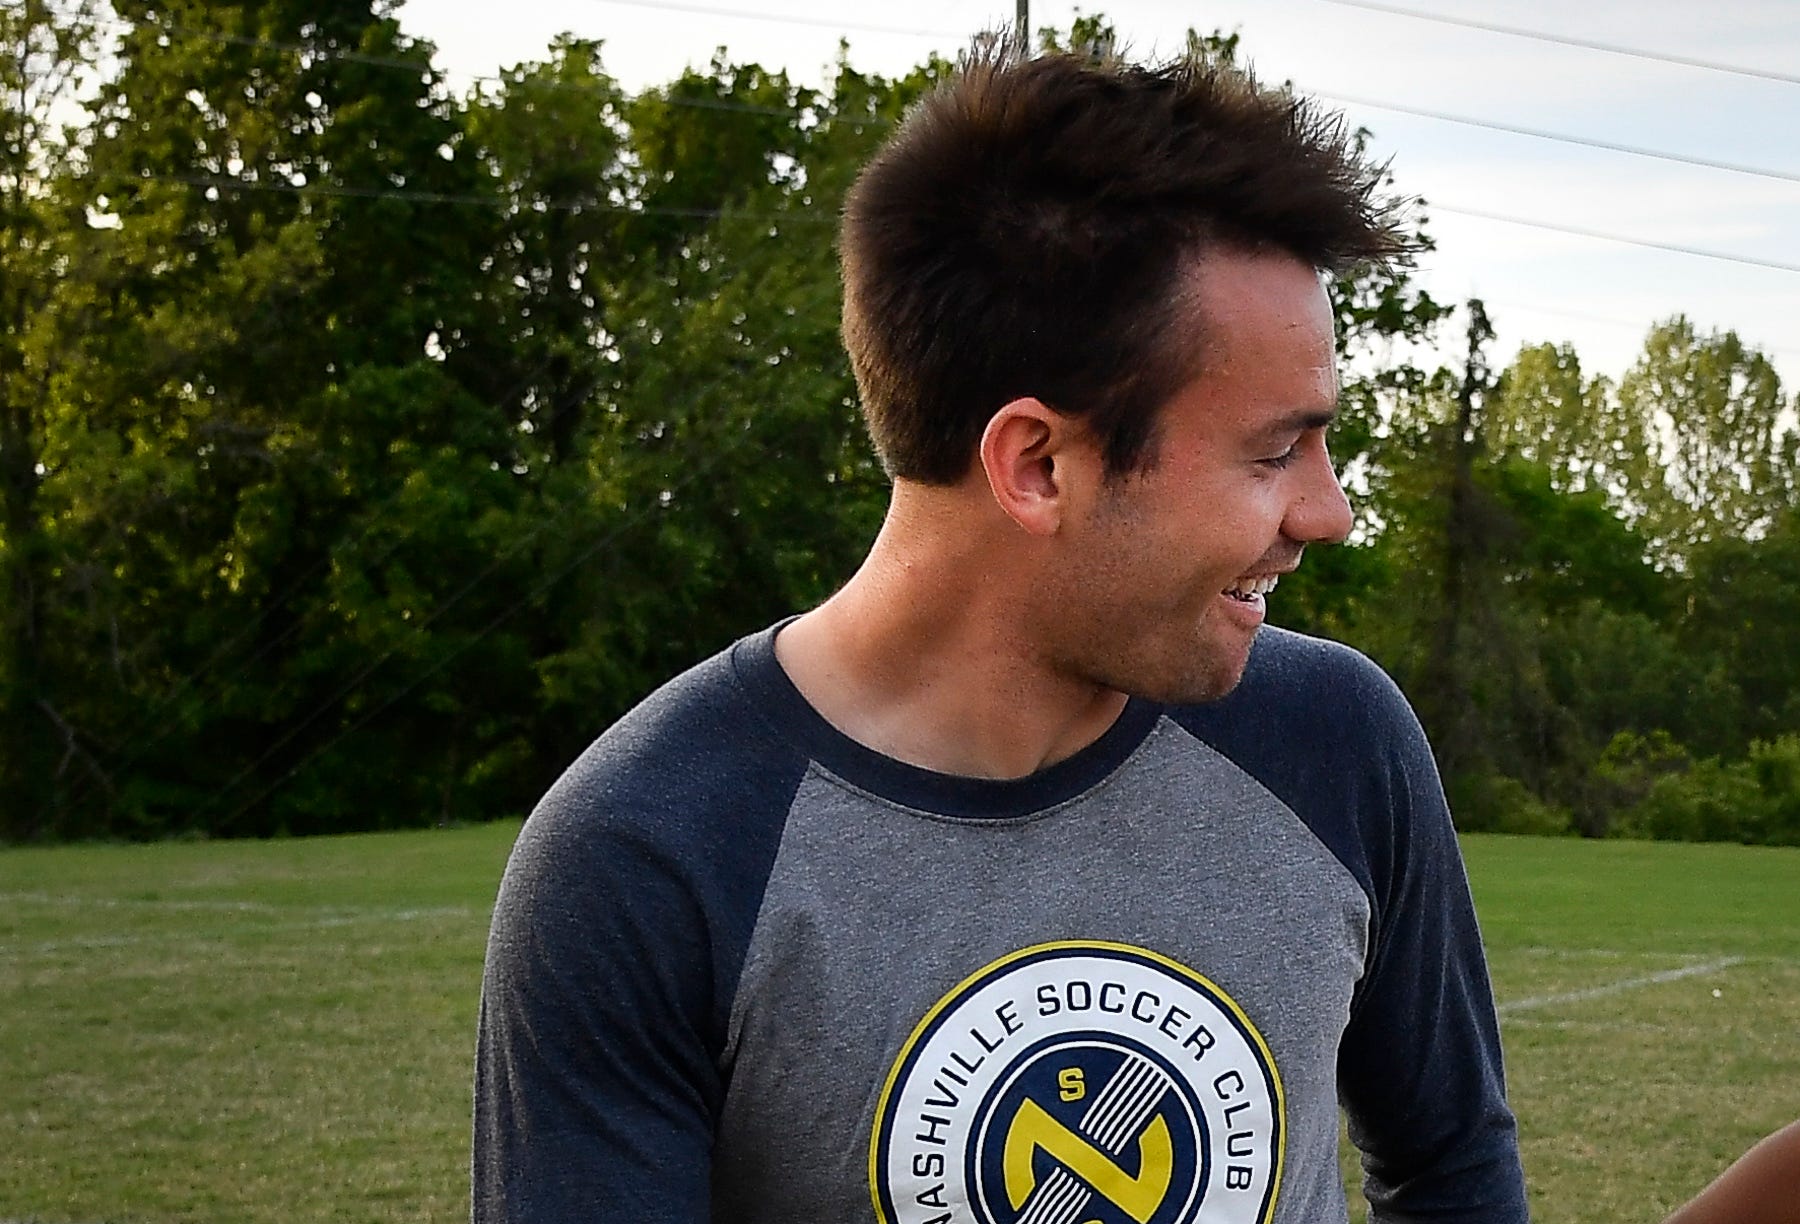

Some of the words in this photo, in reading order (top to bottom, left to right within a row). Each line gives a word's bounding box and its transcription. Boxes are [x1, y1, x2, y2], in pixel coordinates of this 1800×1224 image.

[1037, 980, 1216, 1062] SOCCER
[1213, 1069, 1255, 1191] CLUB
[1057, 1067, 1086, 1102] S
